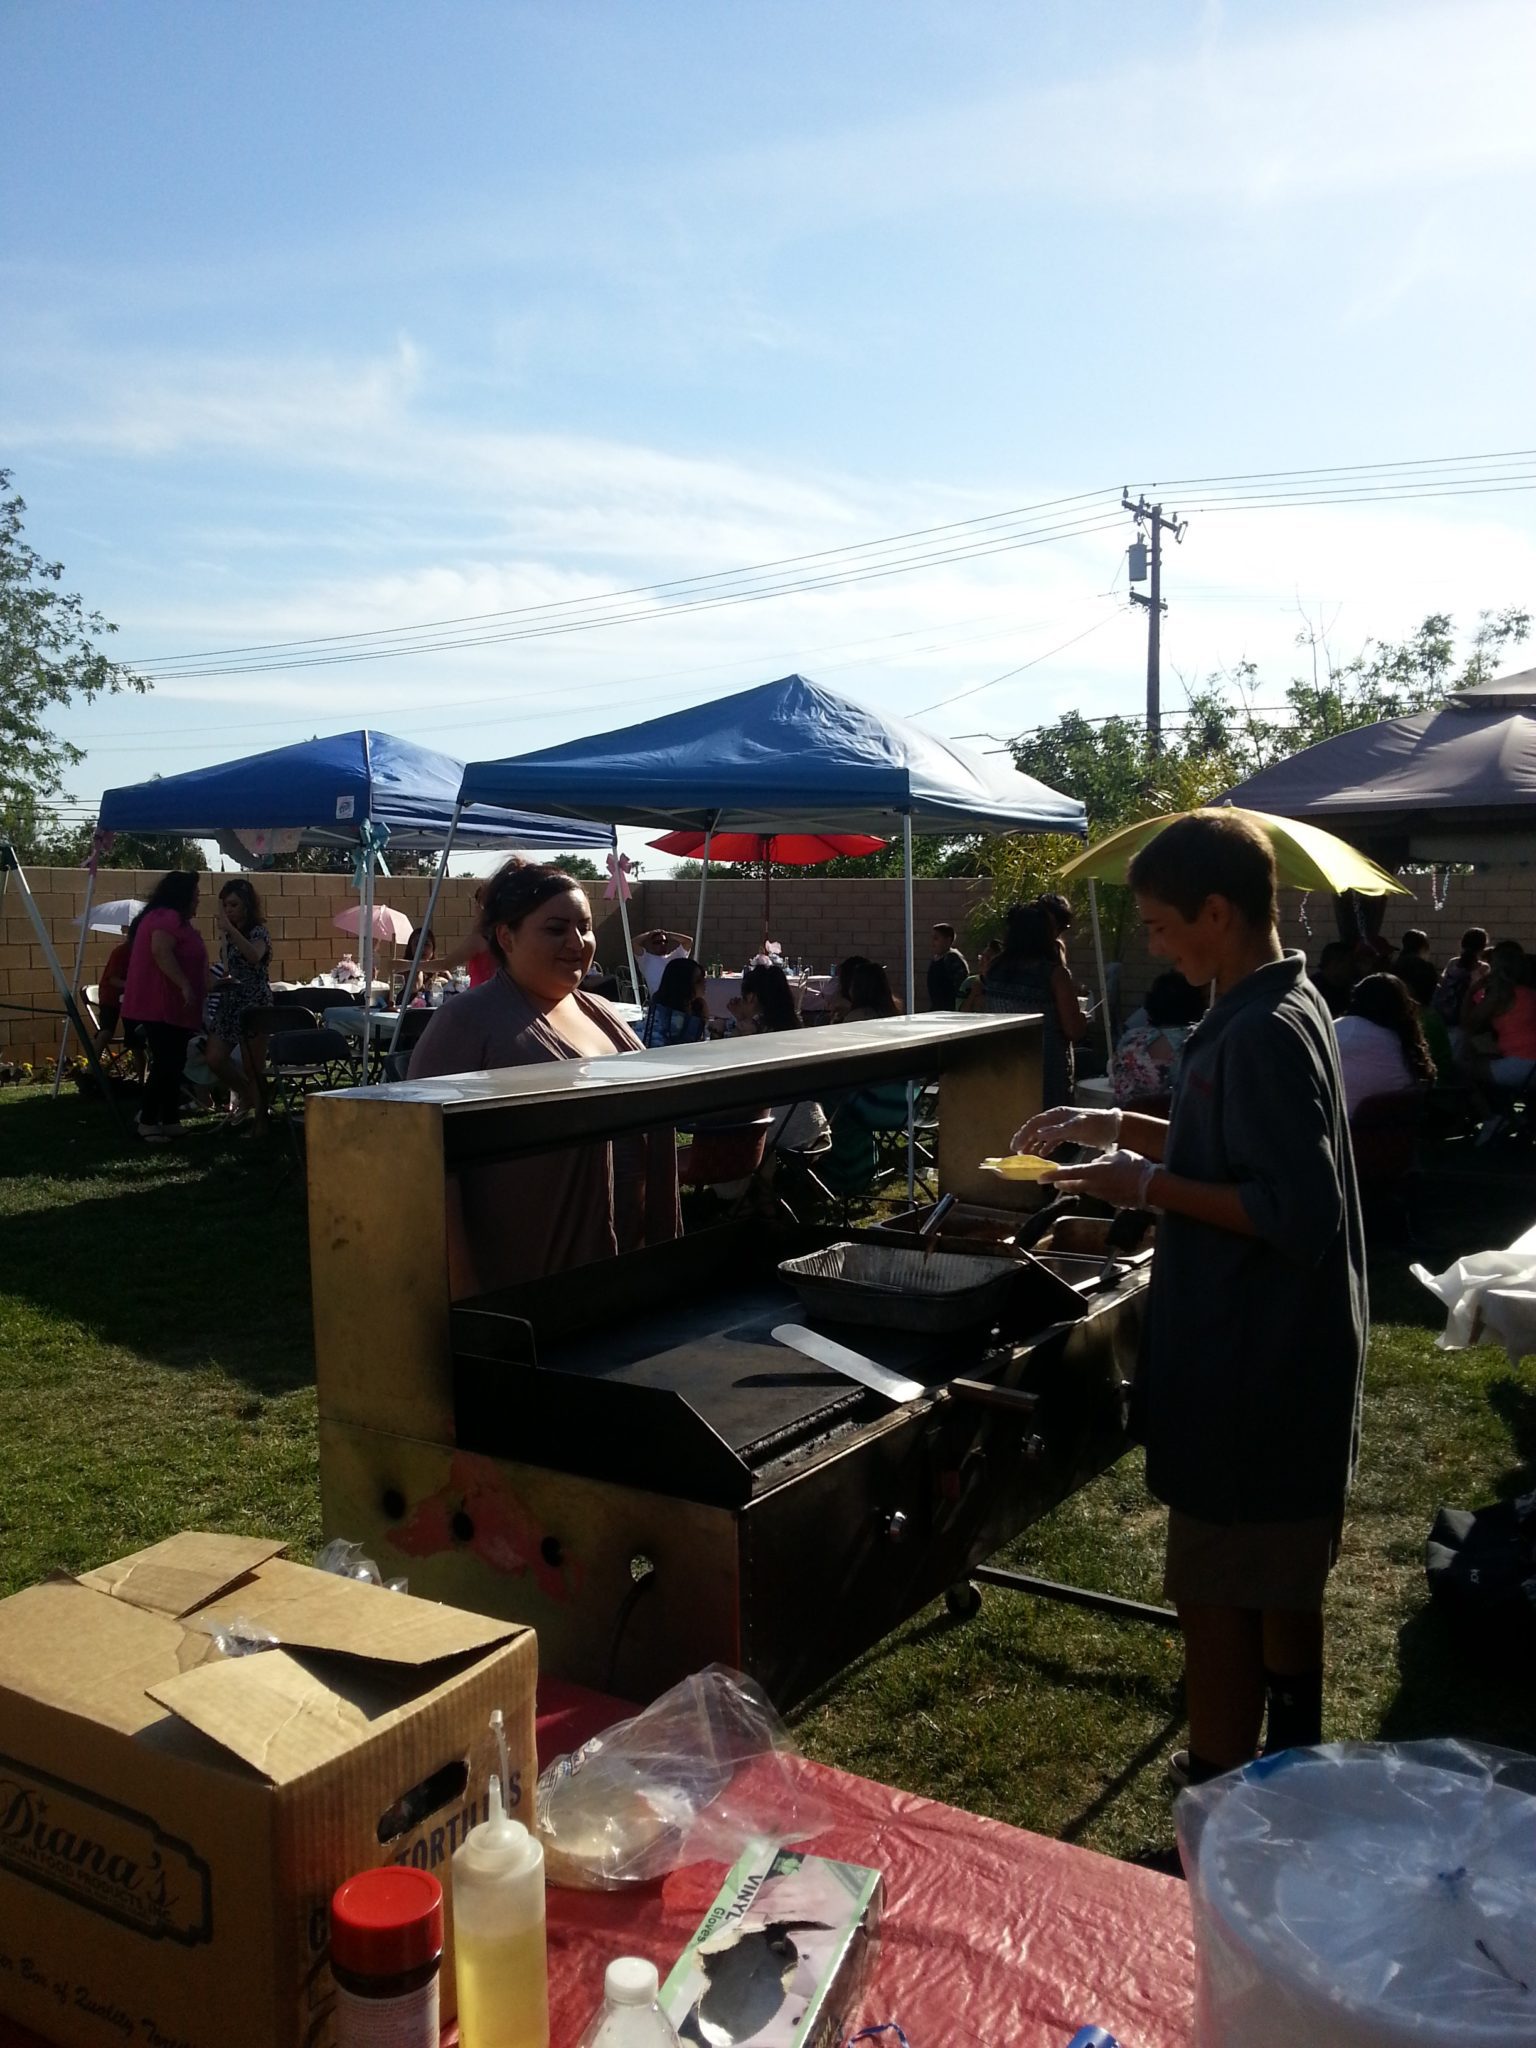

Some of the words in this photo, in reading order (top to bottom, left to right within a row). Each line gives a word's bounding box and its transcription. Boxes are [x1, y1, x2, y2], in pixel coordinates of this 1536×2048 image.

[395, 1770, 522, 1870] TORTIS
[0, 1781, 180, 1907] Diana's
[725, 1874, 763, 1921] VINYL
[696, 1906, 725, 1943] Gloves
[53, 1980, 69, 2005] of
